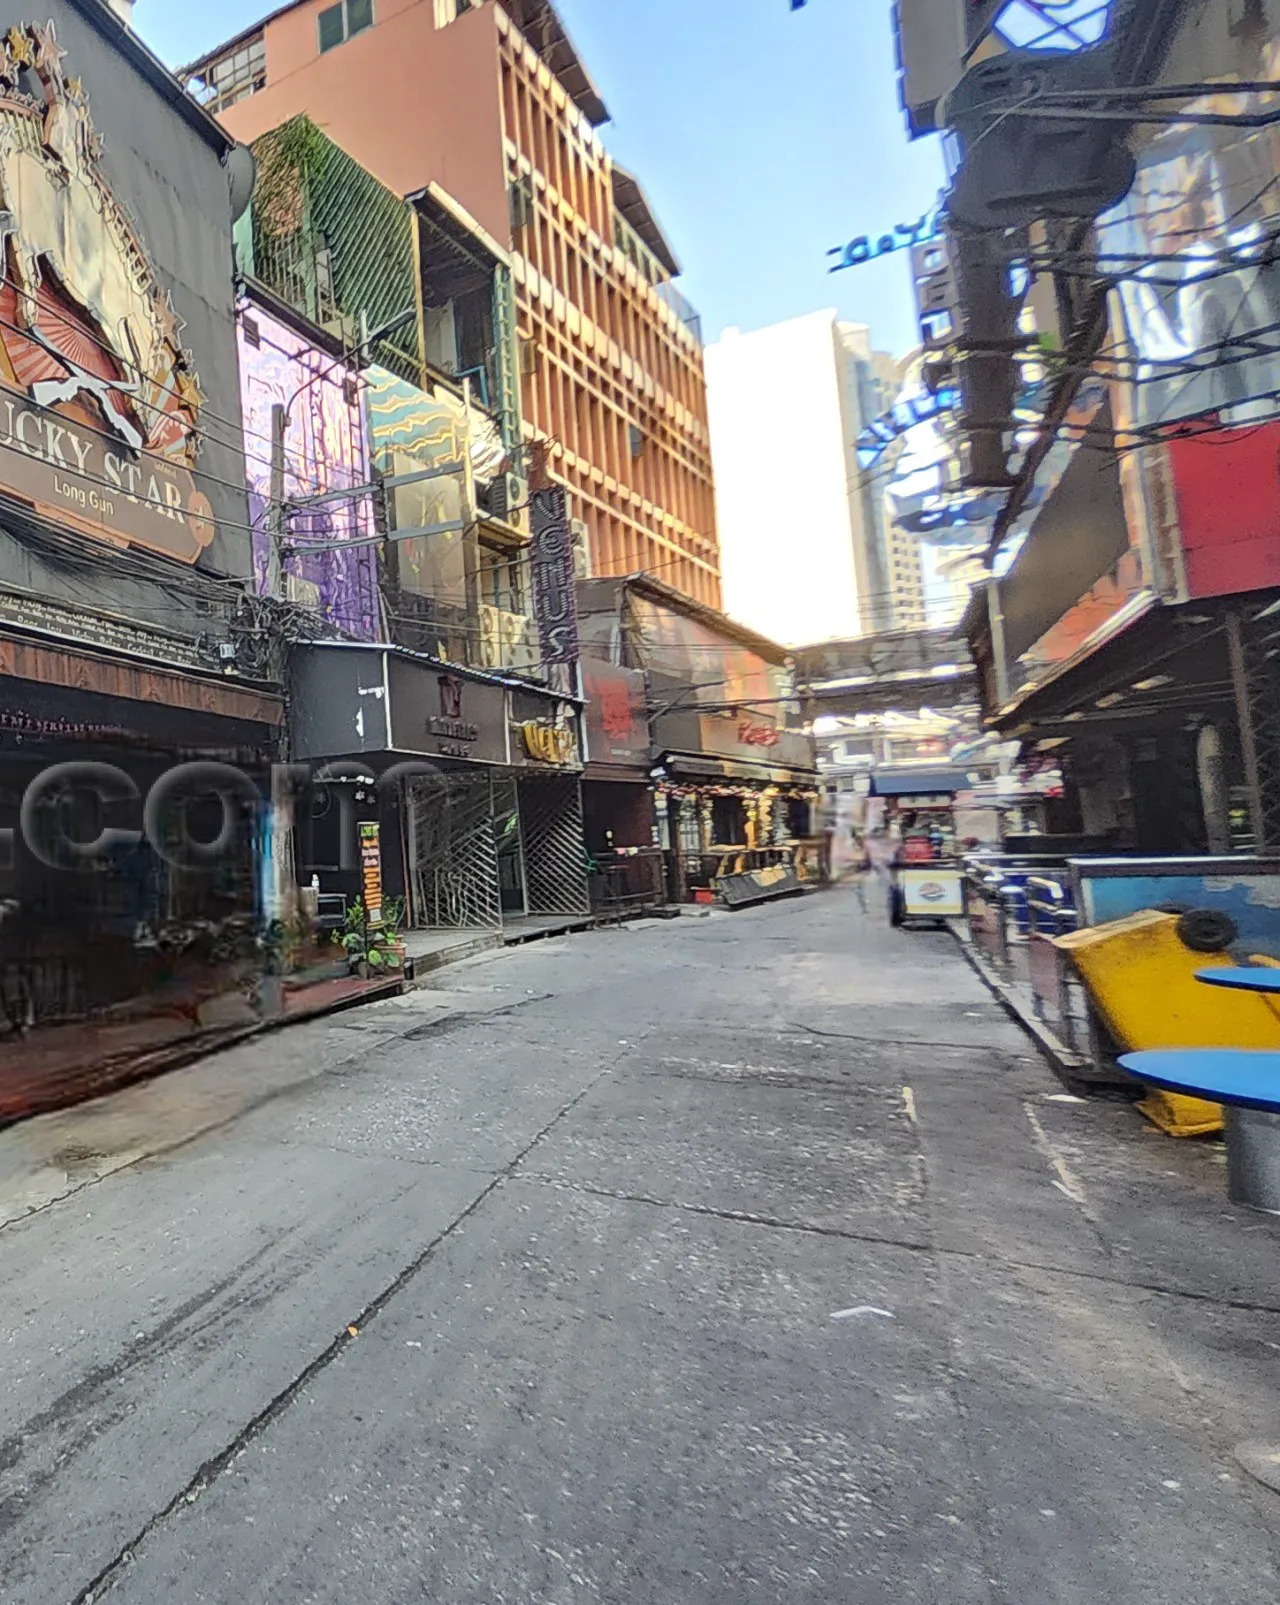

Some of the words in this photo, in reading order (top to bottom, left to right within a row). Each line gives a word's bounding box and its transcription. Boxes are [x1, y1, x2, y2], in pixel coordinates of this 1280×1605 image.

[54, 475, 86, 508] Long
[89, 491, 114, 516] Gun
[103, 451, 186, 524] STAR
